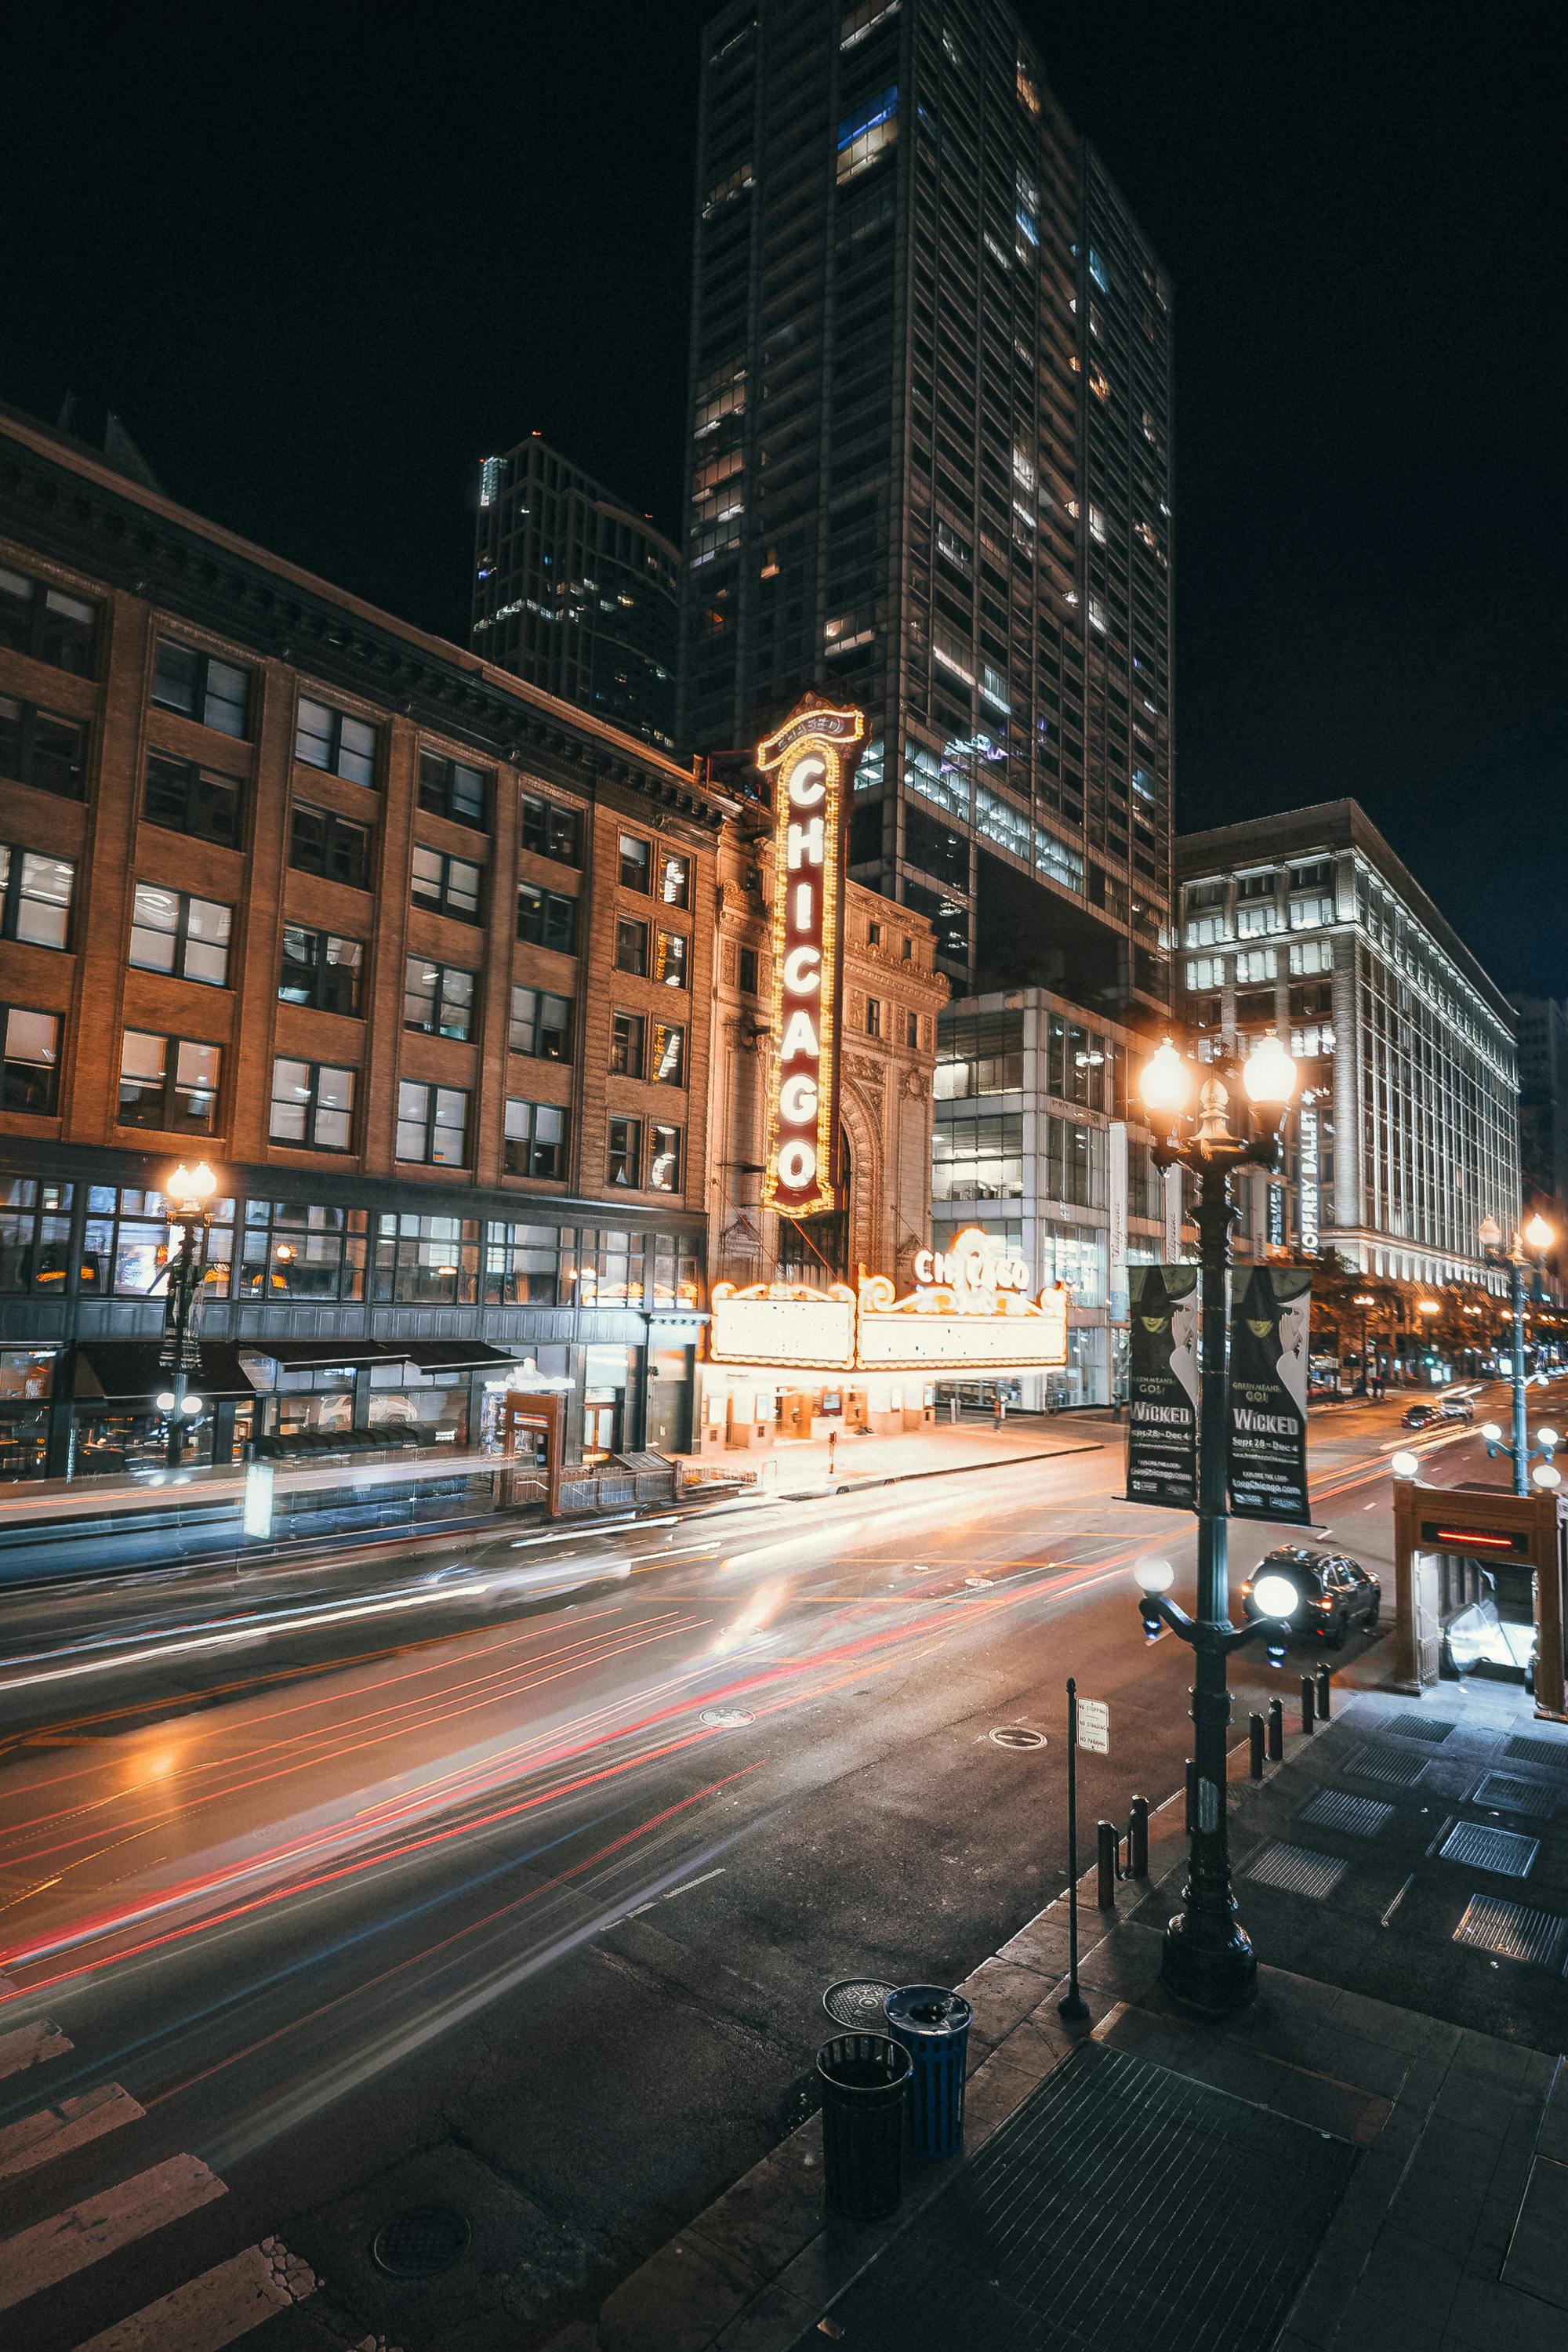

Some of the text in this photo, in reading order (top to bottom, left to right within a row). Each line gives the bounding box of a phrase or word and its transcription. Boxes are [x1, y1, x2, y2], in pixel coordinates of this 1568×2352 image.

[776, 757, 826, 1191] CHICAGO
[1300, 1109, 1319, 1254] JOFFREY BALLET
[1245, 1391, 1268, 1403] GO!
[1232, 1407, 1299, 1435] WICKED
[1254, 1439, 1265, 1449] 28
[846, 1989, 884, 1999] CITY
